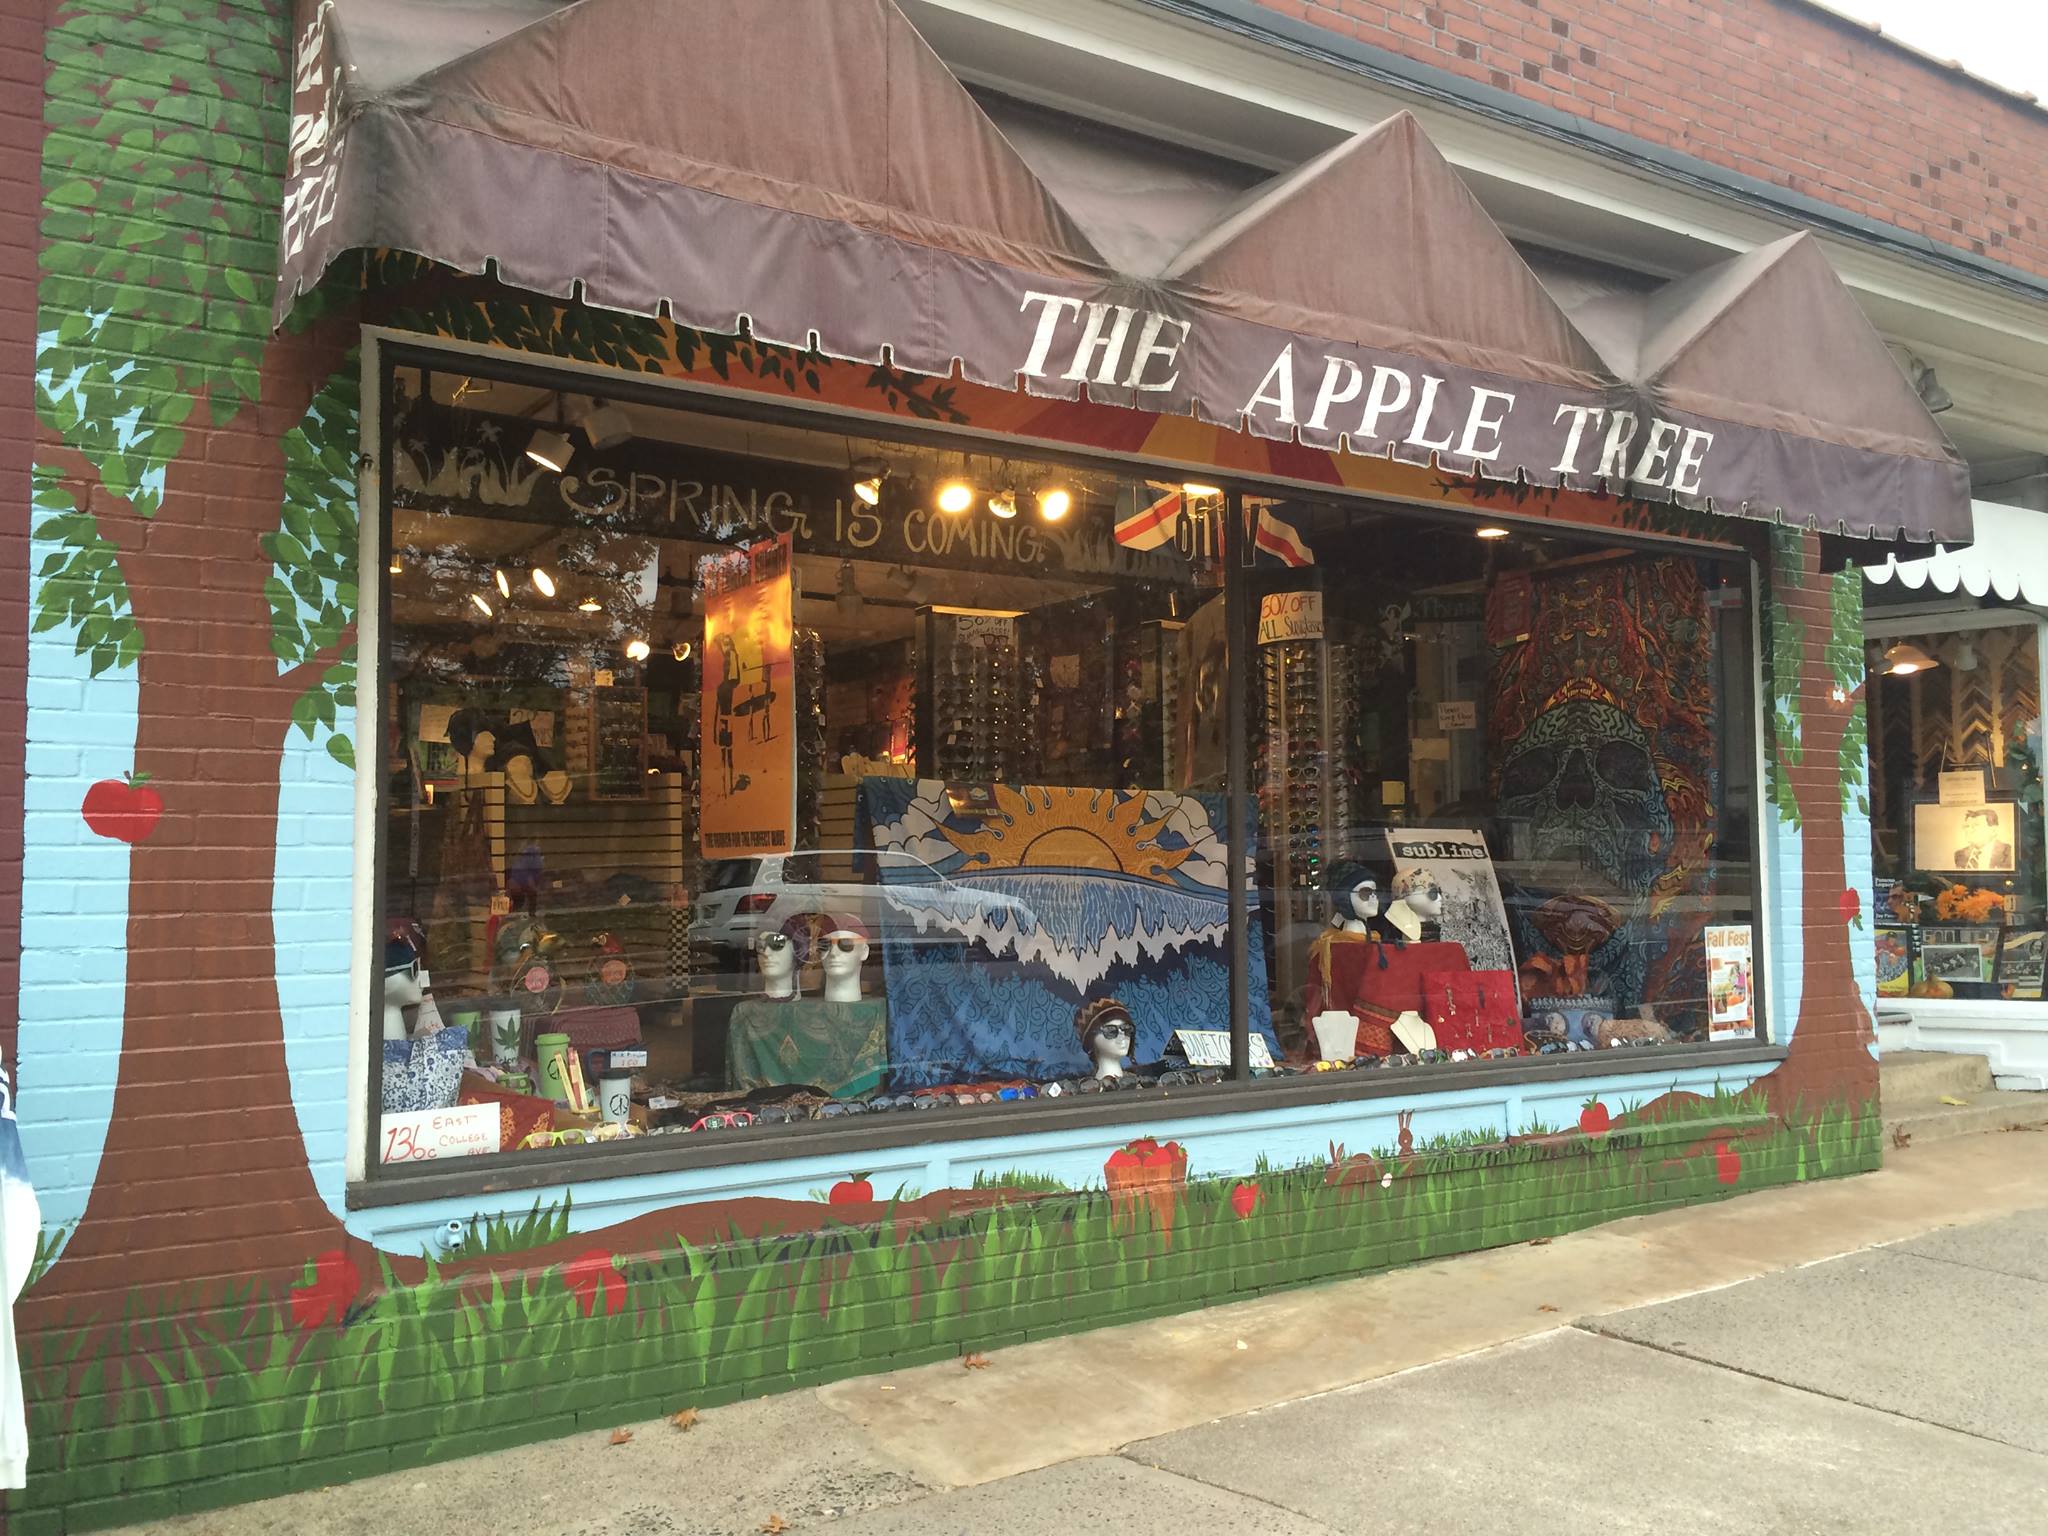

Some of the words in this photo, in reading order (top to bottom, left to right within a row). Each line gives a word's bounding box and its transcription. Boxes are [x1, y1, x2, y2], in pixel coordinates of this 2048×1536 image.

[1014, 289, 1191, 392] THE
[1236, 341, 1515, 461] APPLE
[1549, 402, 1714, 495] TREE
[559, 467, 813, 539] SPRING
[835, 498, 882, 548] IS
[1291, 596, 1316, 612] OFF
[1260, 619, 1282, 640] ALL
[1402, 843, 1484, 858] sublime
[1707, 930, 1725, 948] Fall
[1728, 928, 1750, 946] Fest
[432, 1114, 477, 1129] EAST
[439, 1133, 488, 1147] COLLEGE
